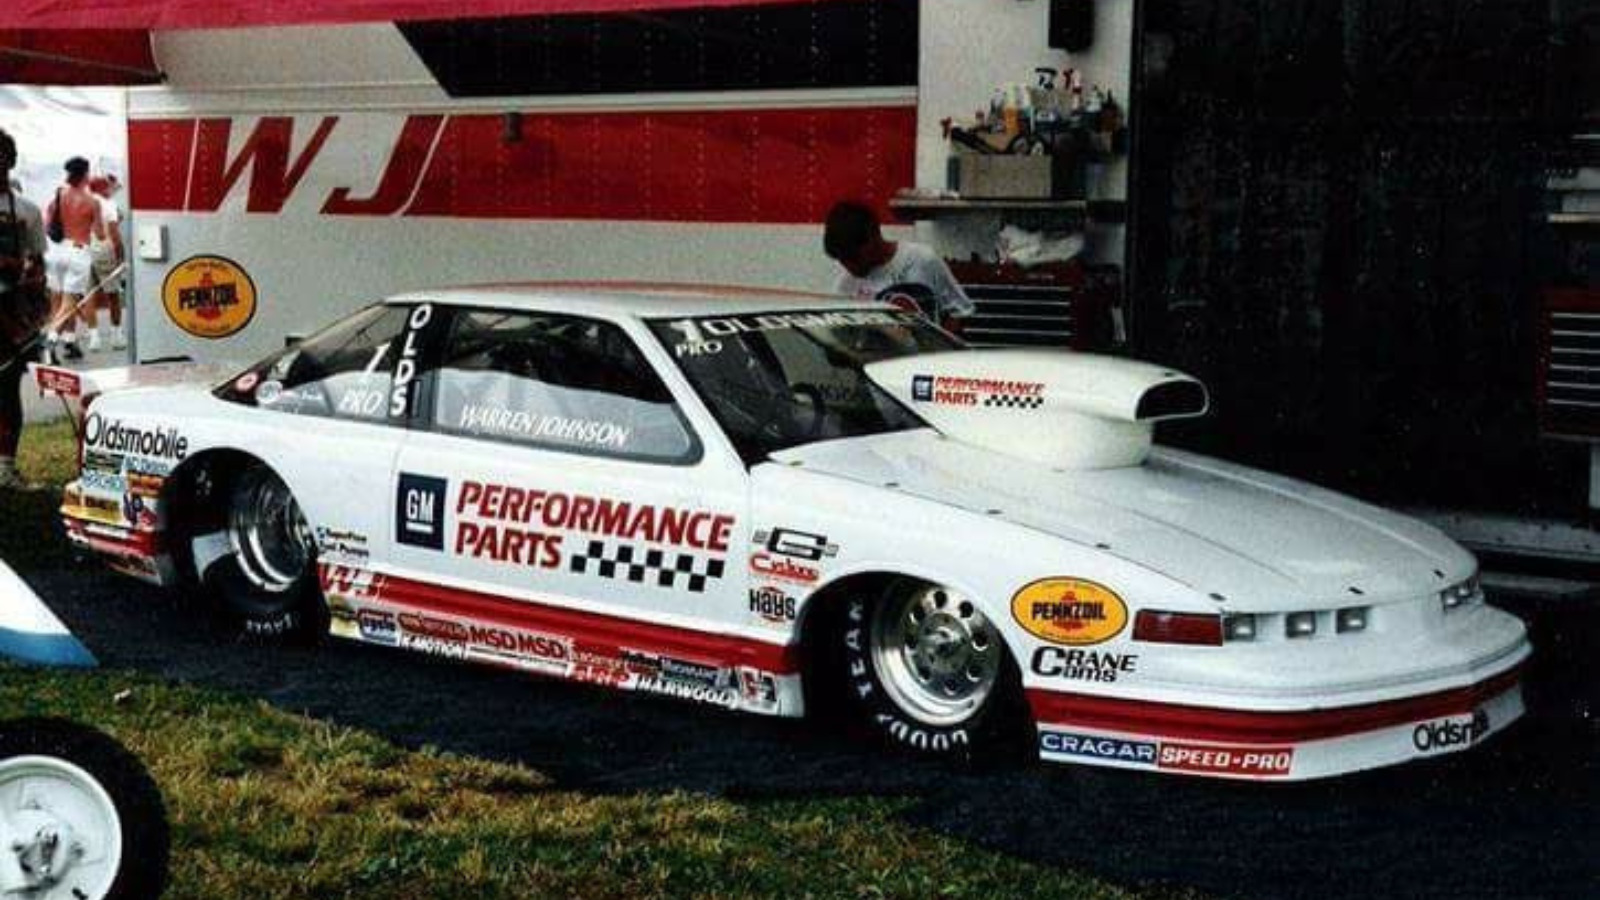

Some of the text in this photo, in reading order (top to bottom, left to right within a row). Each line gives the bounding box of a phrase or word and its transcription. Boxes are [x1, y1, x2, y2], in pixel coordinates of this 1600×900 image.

[178, 283, 239, 311] PENNZOIL
[390, 304, 432, 416] OLDS
[335, 389, 383, 414] PRO
[84, 412, 188, 460] Oldsmobile
[460, 403, 630, 448] WARREN JOHNSON
[405, 488, 435, 524] GM
[456, 480, 736, 551] PERFORMANCE
[455, 522, 563, 570] PARTS
[1032, 602, 1107, 620] PENNZOIL
[469, 626, 516, 650] MSD
[518, 632, 564, 659] MSD
[1041, 733, 1156, 761] CRAGAR
